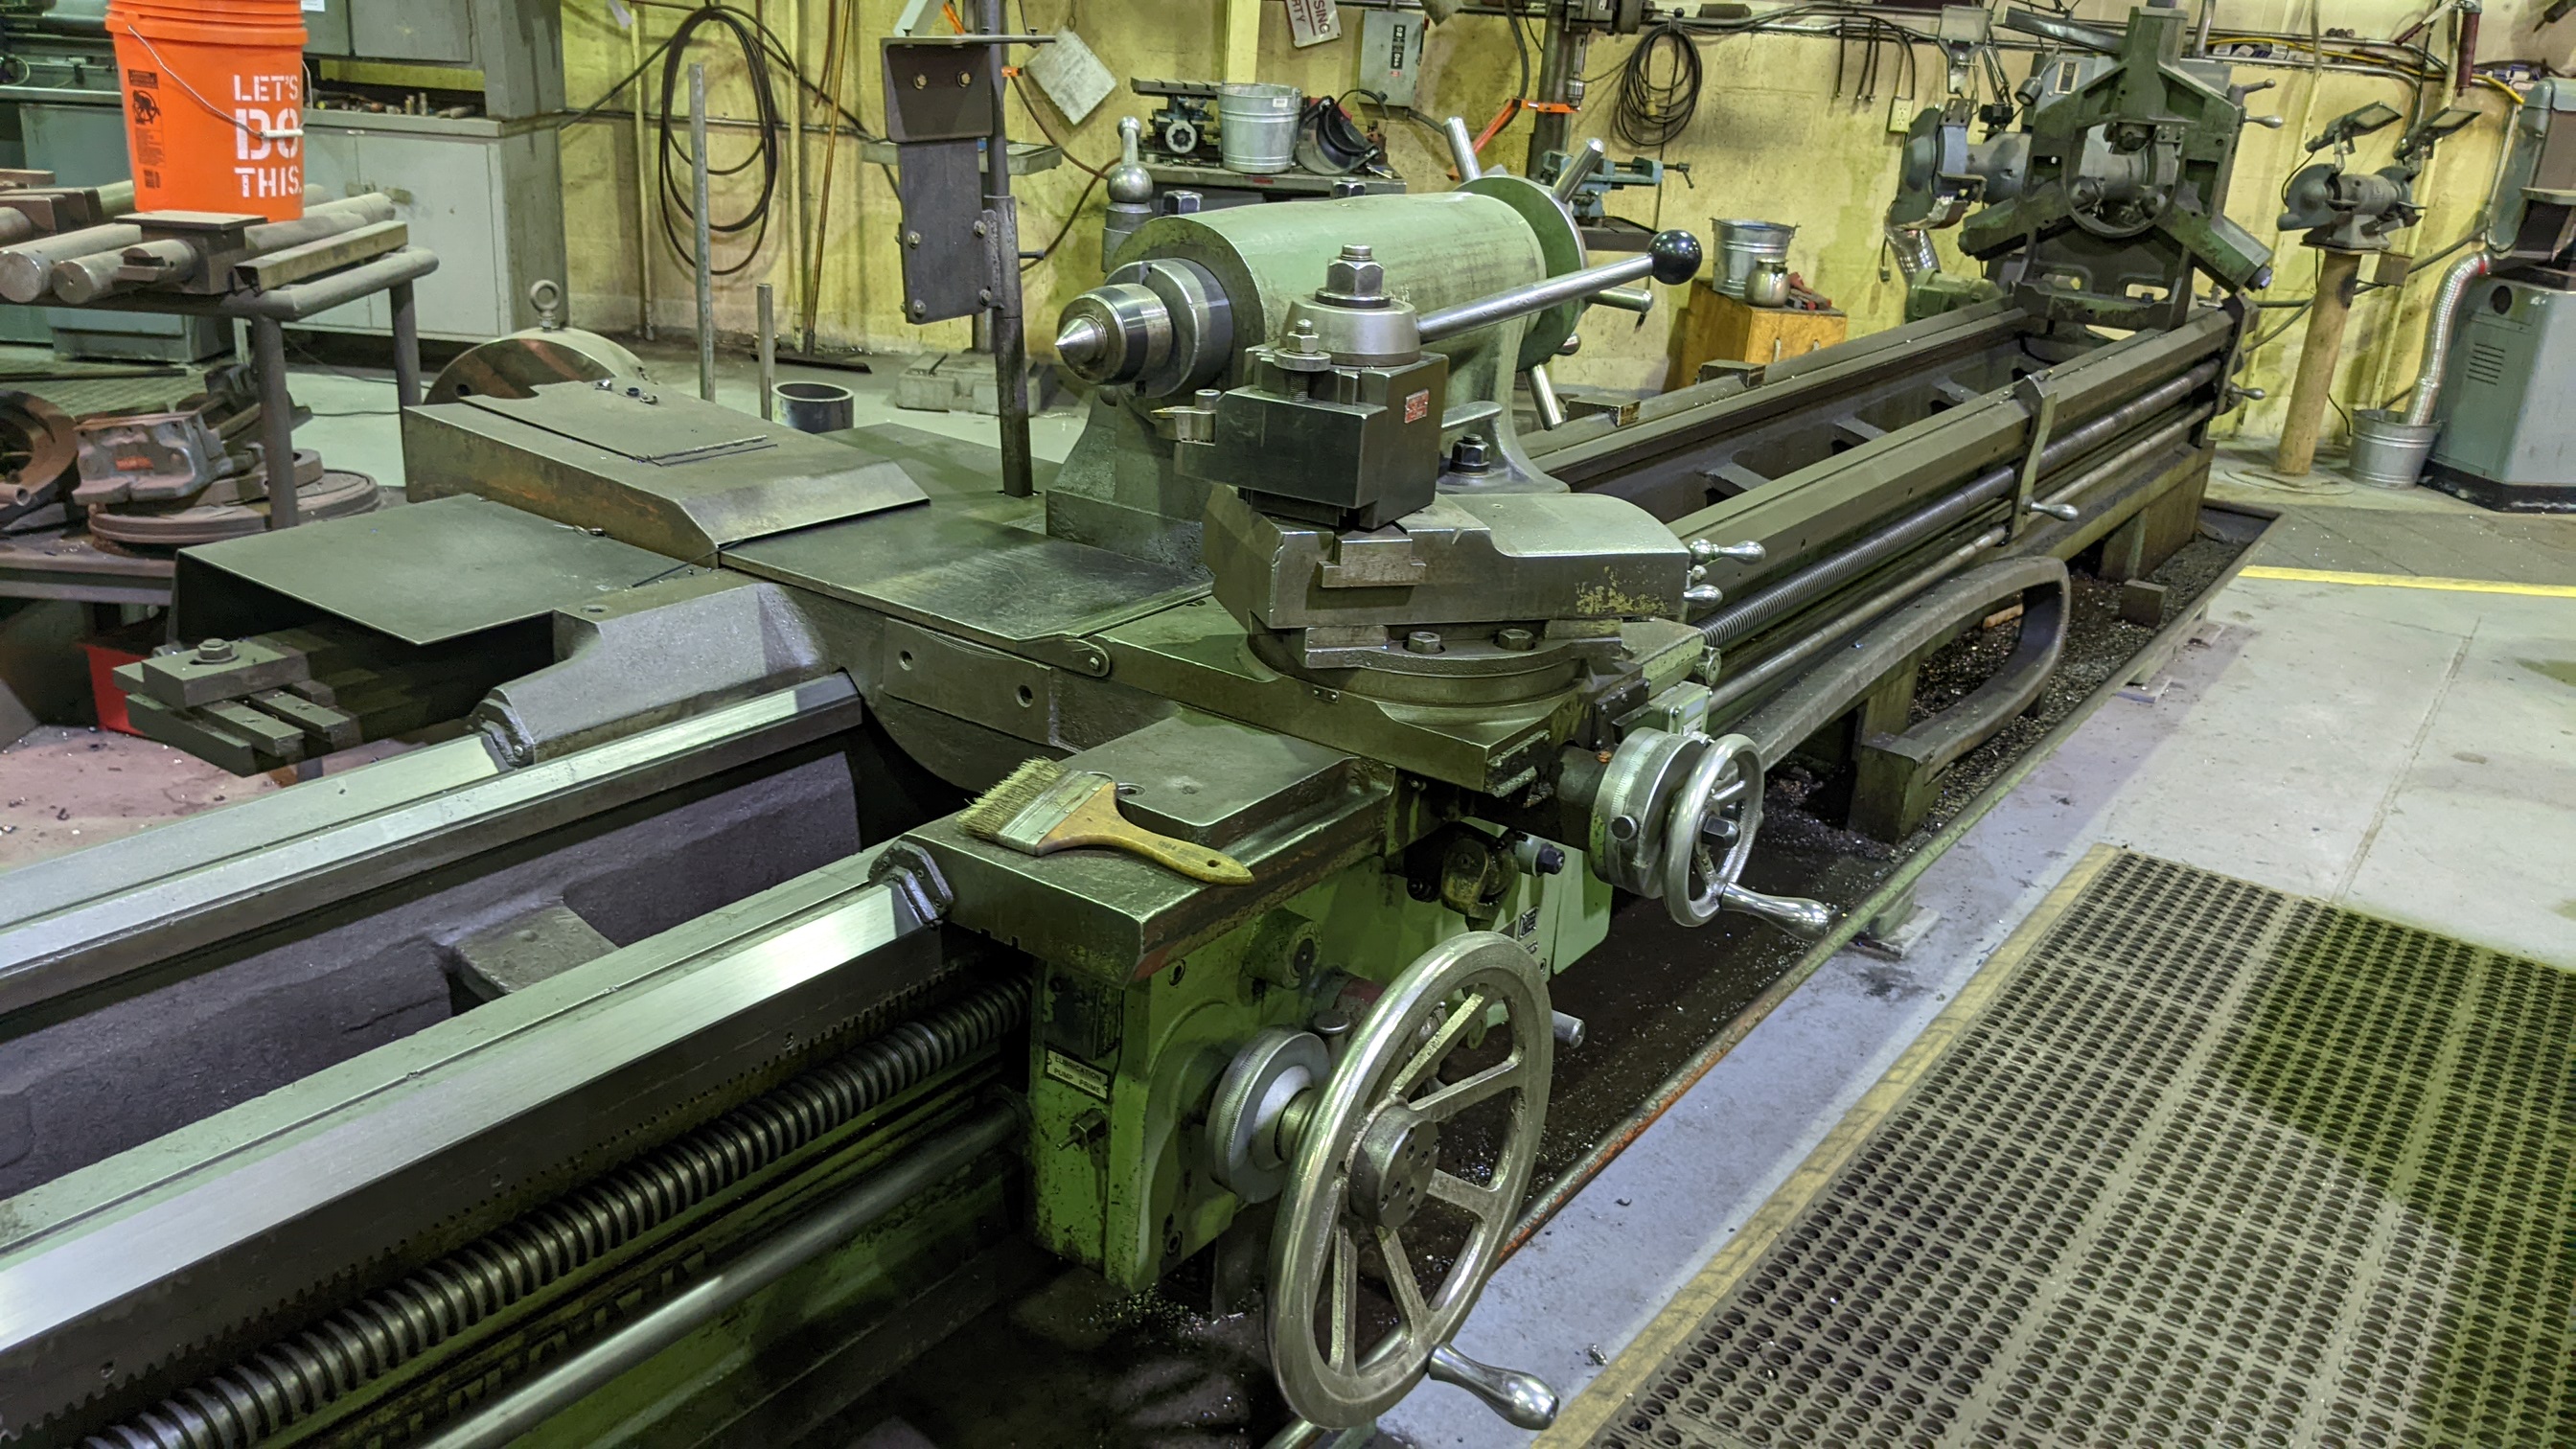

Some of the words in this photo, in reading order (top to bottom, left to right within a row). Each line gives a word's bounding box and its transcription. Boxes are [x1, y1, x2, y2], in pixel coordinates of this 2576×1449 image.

[234, 75, 298, 102] LET'S
[235, 107, 299, 160] DO
[234, 165, 303, 197] THIS.
[1054, 1068, 1074, 1080] PUMP
[1079, 1079, 1101, 1094] PRIME
